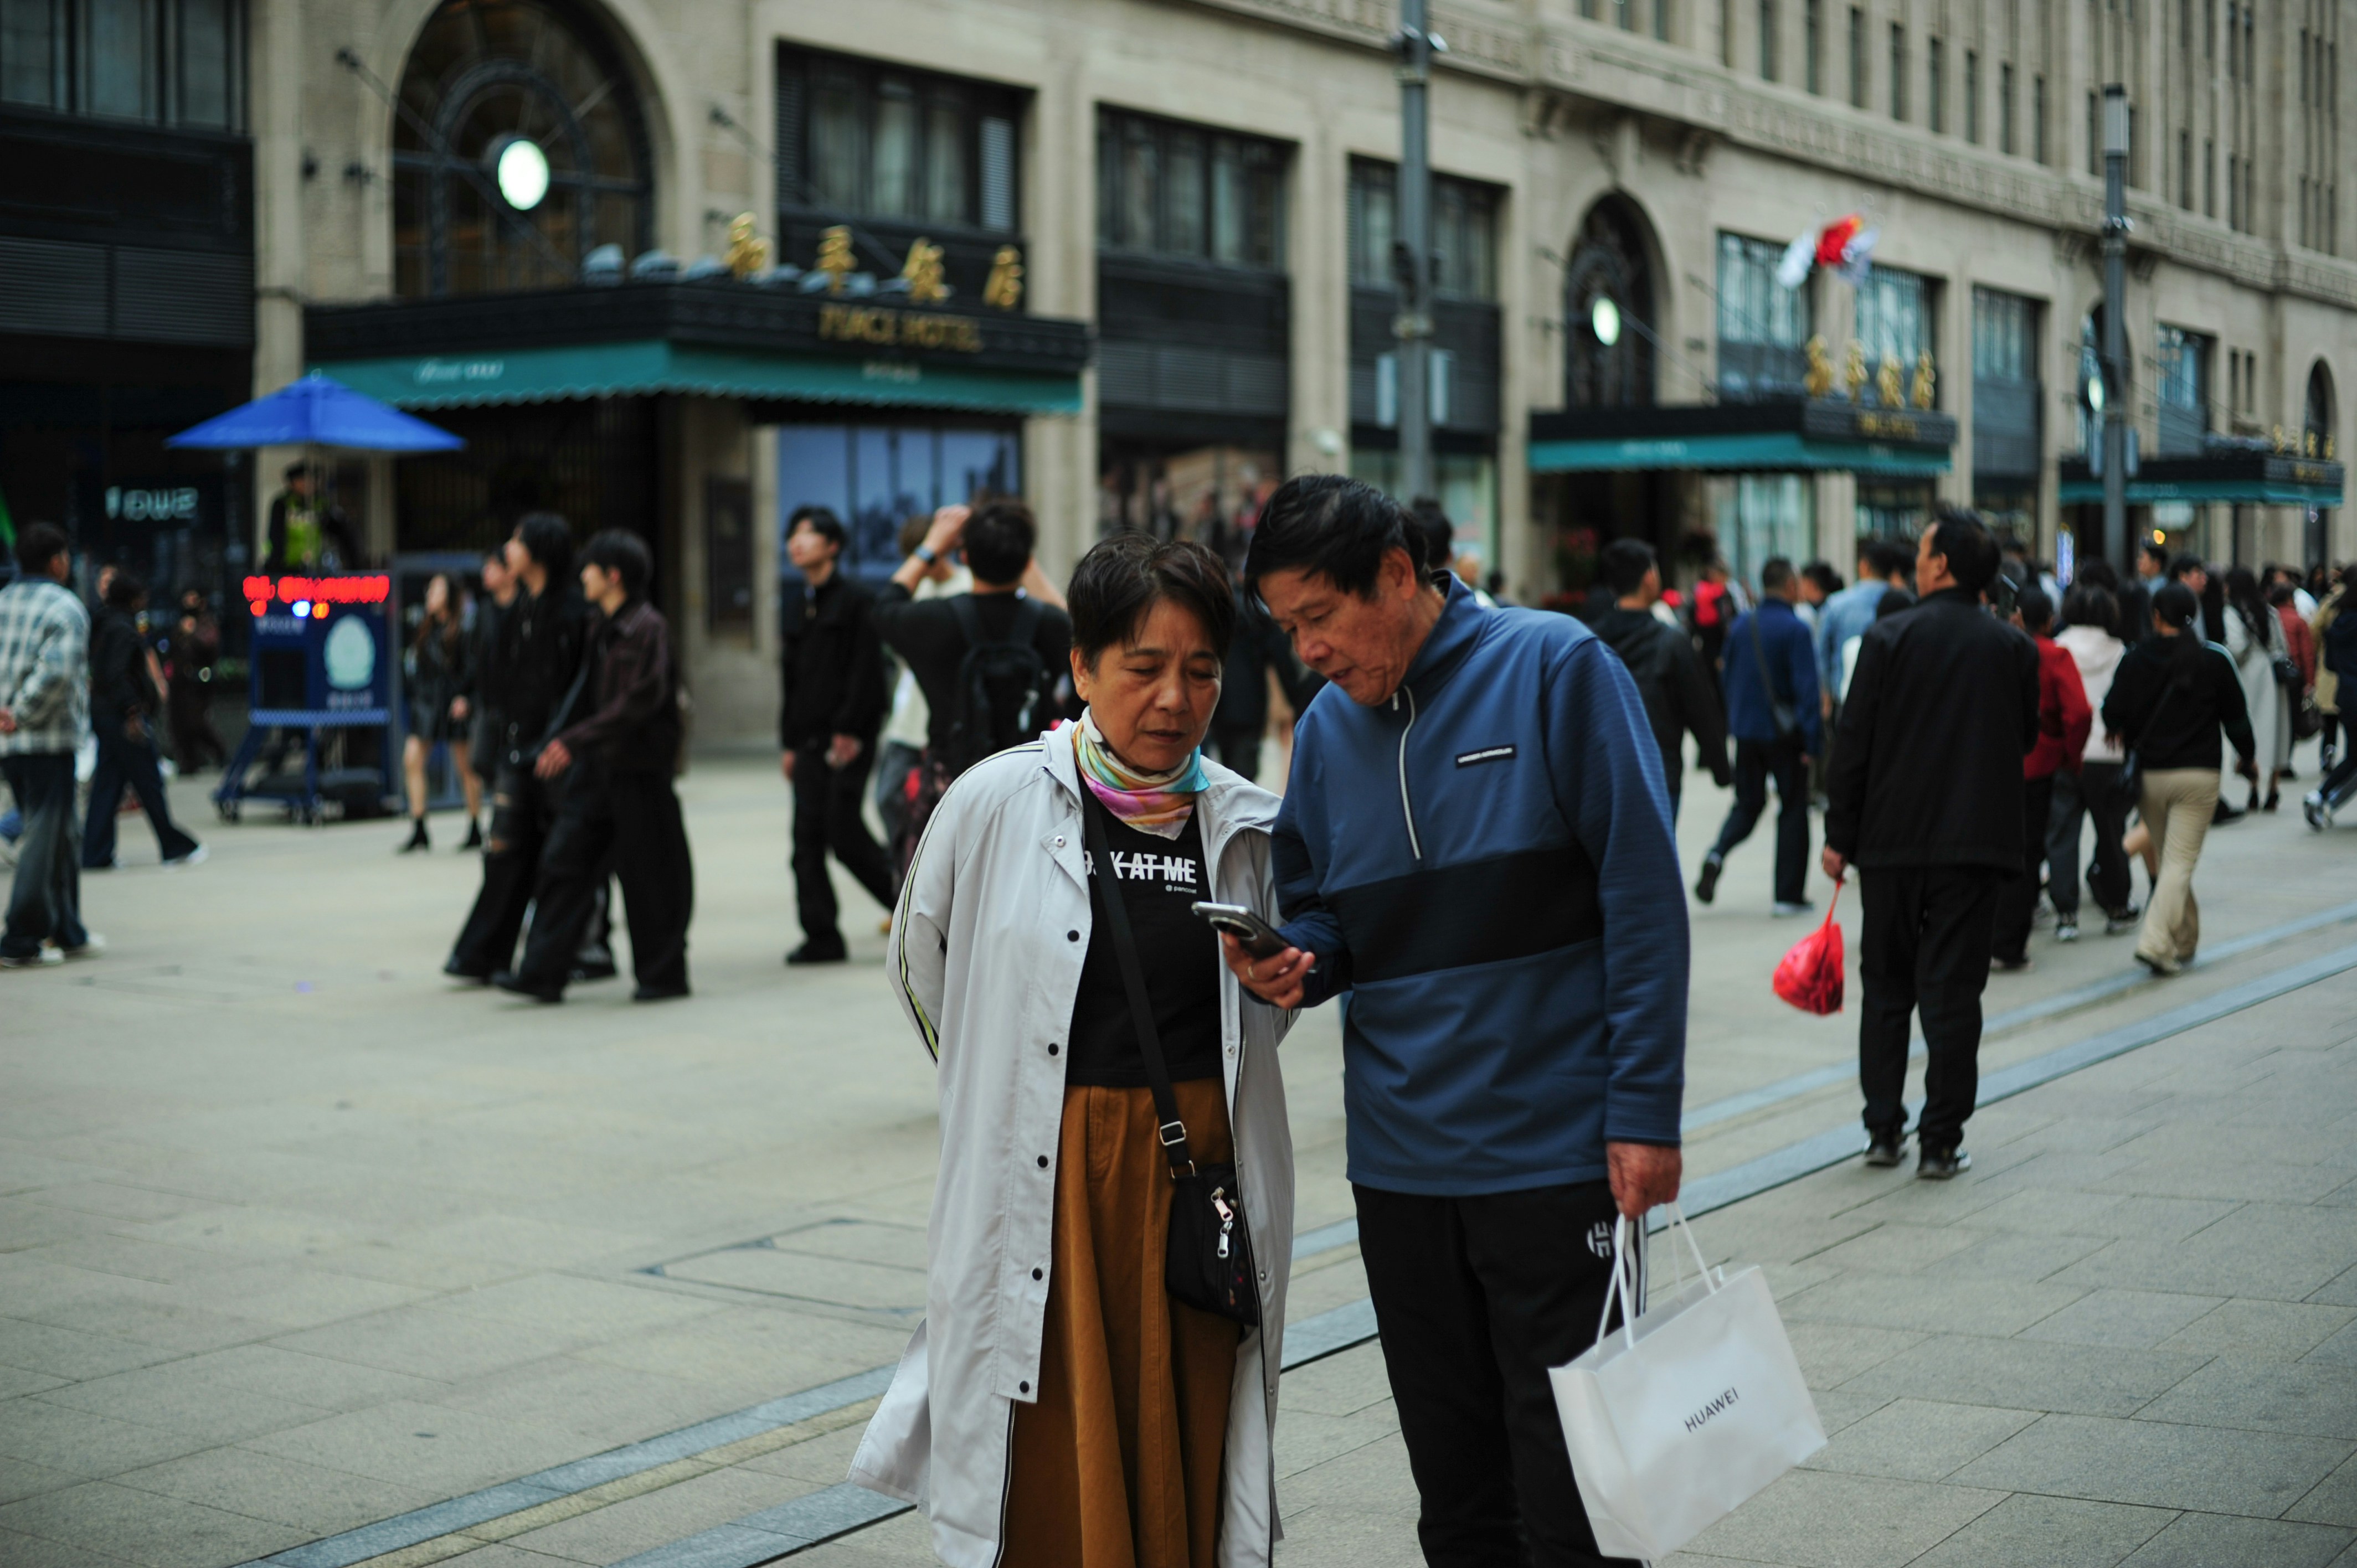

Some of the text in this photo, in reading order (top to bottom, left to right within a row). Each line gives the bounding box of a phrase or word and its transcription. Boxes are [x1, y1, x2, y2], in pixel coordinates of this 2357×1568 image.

[1129, 853, 1157, 879] AT
[1164, 856, 1196, 884] ME
[1684, 1387, 1739, 1432] HUAWEI
